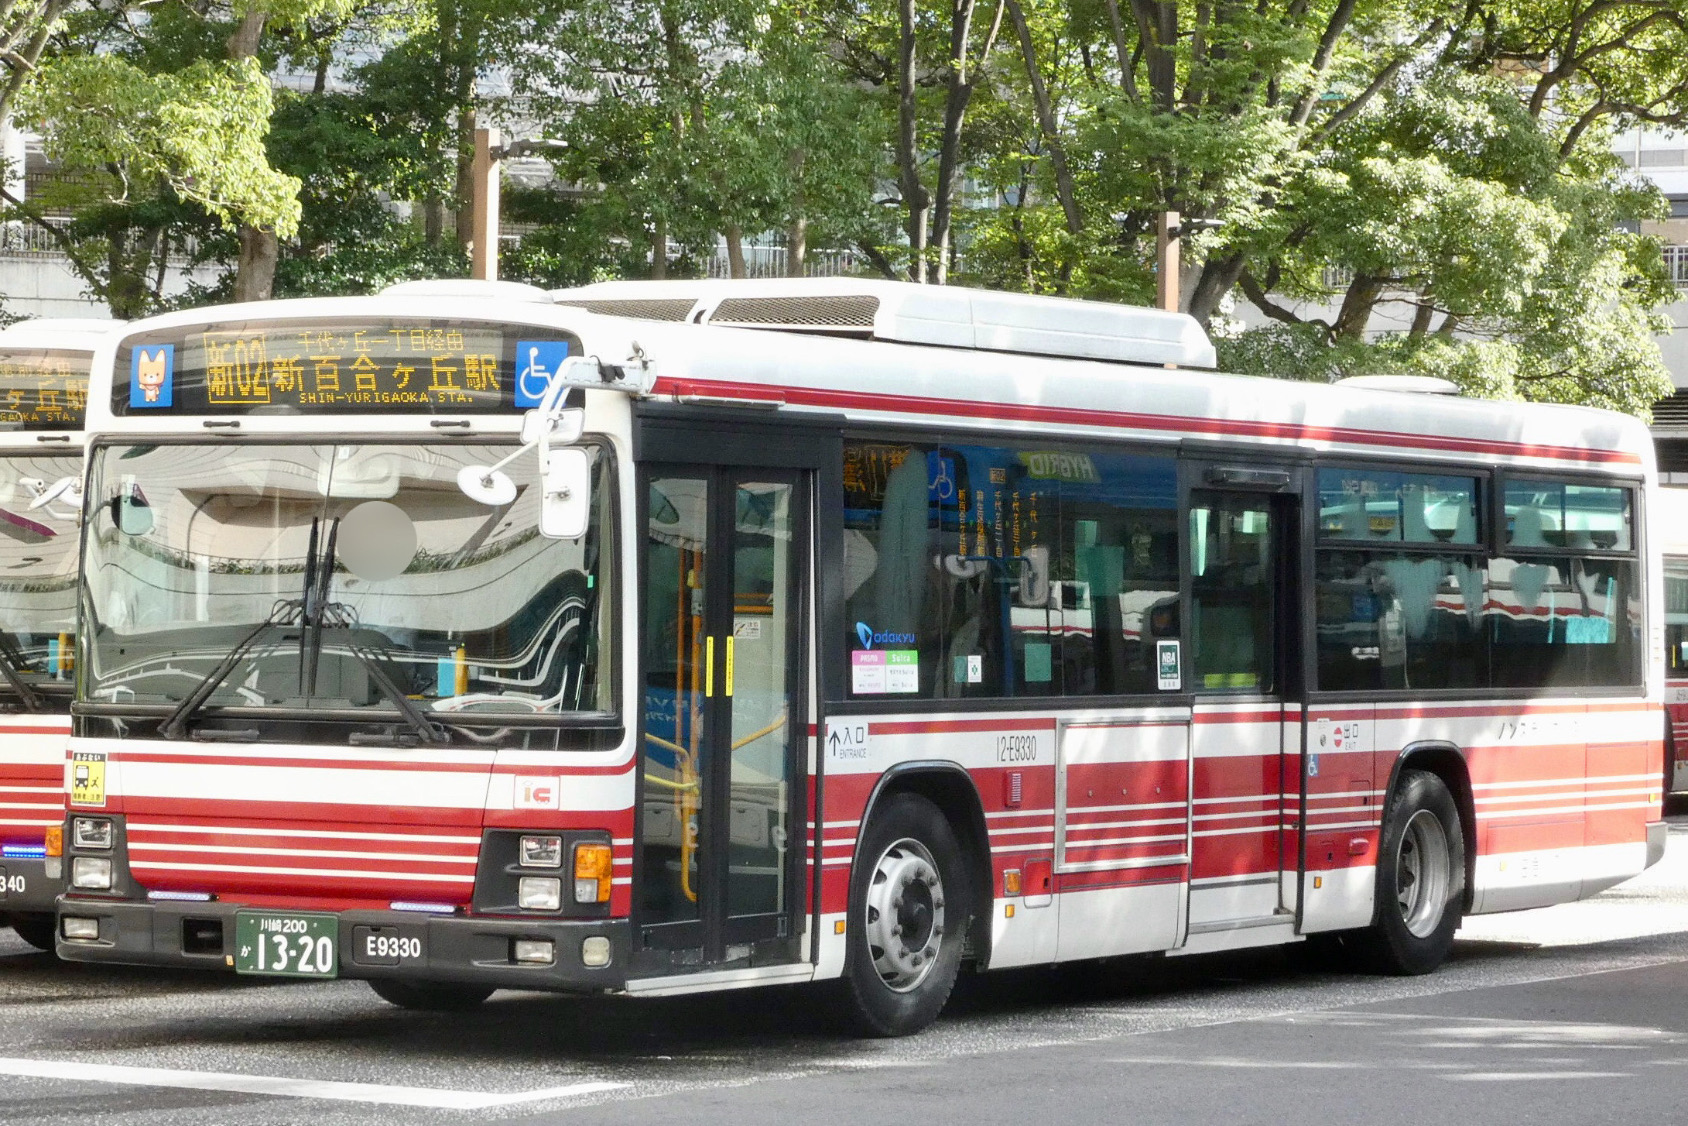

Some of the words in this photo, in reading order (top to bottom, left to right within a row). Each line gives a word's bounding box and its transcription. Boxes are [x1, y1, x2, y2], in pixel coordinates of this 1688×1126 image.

[297, 329, 464, 352] 千代ヶ丘一丁目経由
[207, 339, 268, 397] 新02
[272, 352, 500, 392] 新百合ヶ丘駅
[299, 391, 429, 403] SHIN-YURIGAOKA
[437, 392, 473, 403] STA.
[46, 411, 76, 422] STA.
[891, 653, 911, 662] Suica
[843, 726, 864, 744] 入口
[839, 747, 866, 760] ENTRANCE
[366, 935, 421, 958] E9330
